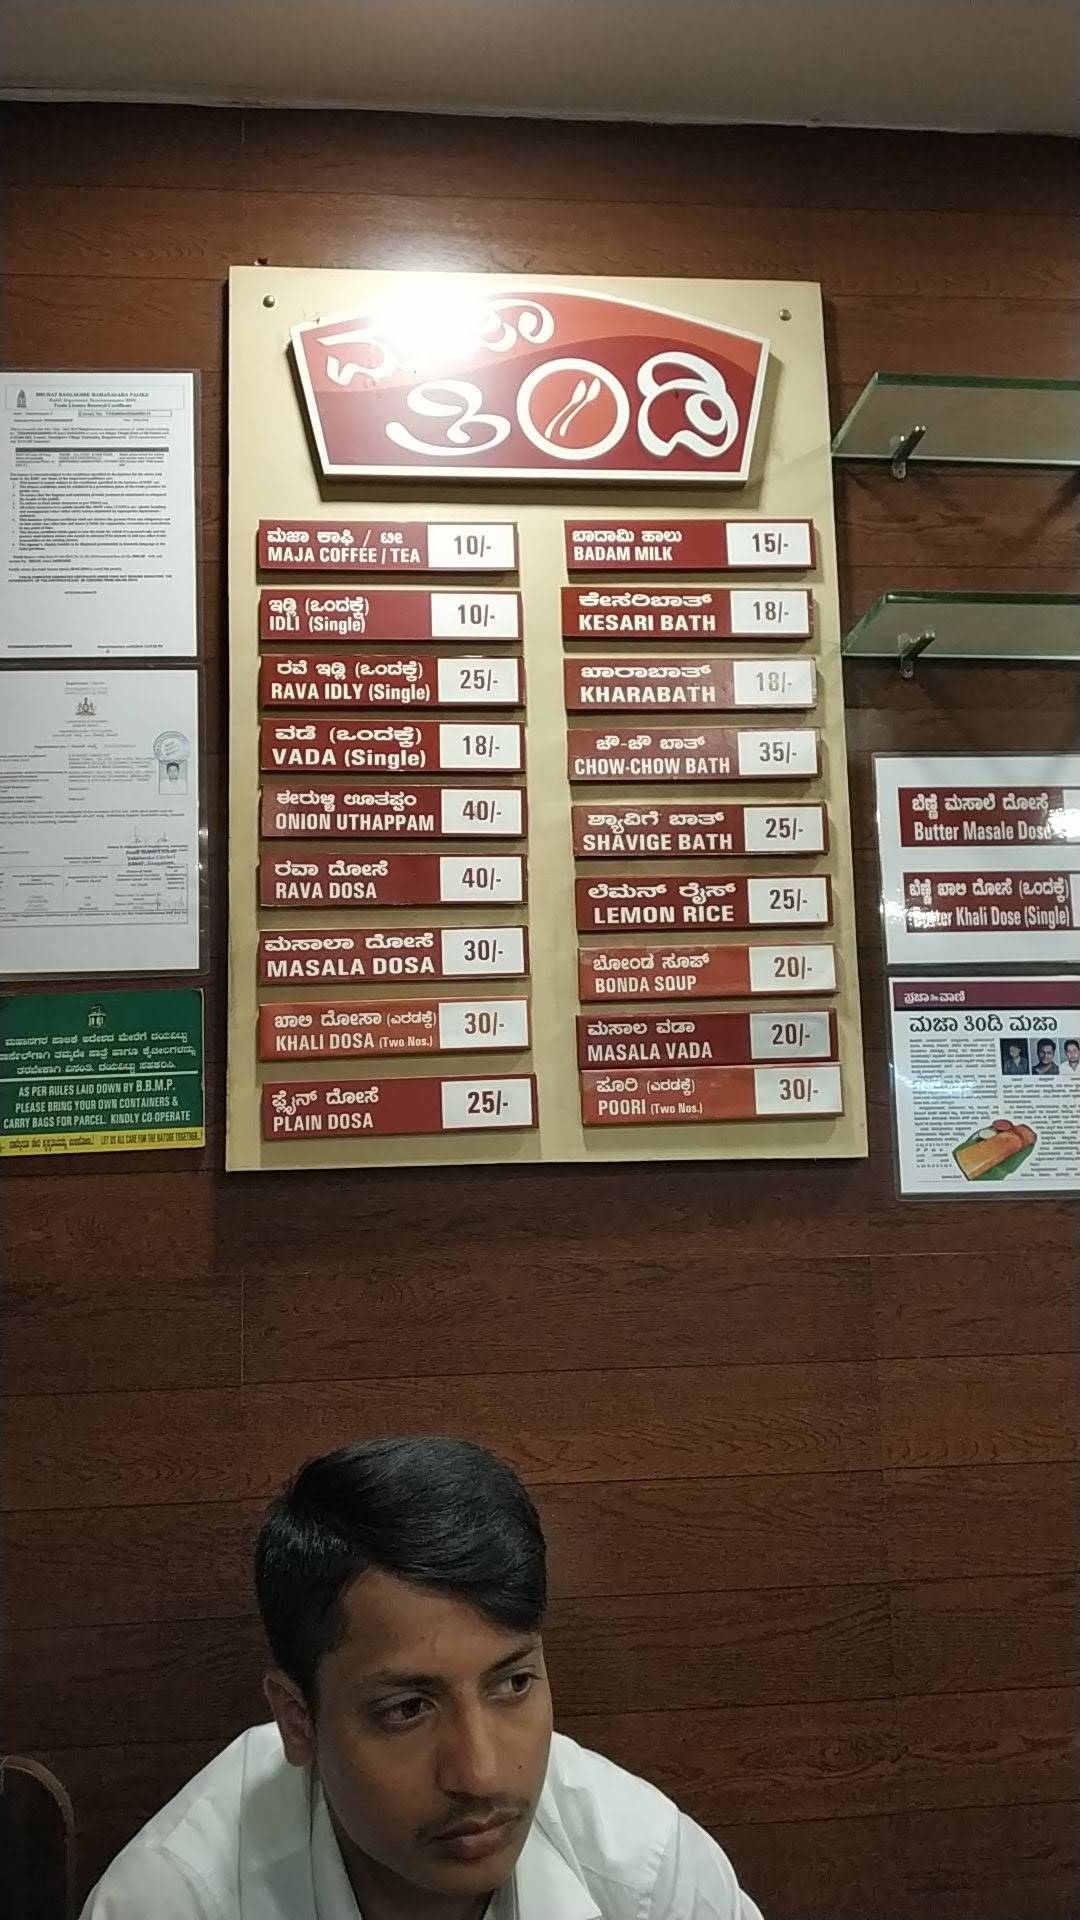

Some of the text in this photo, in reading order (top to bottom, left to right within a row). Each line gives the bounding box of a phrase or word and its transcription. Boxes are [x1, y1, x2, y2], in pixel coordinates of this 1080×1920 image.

[267, 528, 309, 542] ಮಜಾ
[318, 529, 353, 545] ಕಾಫಿ
[363, 530, 371, 546] /
[573, 530, 681, 542] ಬಾದಾಮಿ ಹಾಲು
[752, 532, 788, 554] 15/-
[268, 547, 420, 564] MAJA COFFEE / TEA
[454, 535, 491, 558] 10/-
[574, 547, 673, 561] BADAM MILK
[269, 597, 369, 618] ಇಡ್ಲಿ (ಒಂದಕ್ಕೆ)
[579, 592, 712, 607] ಕೇಸರಿಬಾತ್
[458, 604, 496, 627] 10/-
[753, 601, 789, 623] 18/-
[269, 616, 365, 634] IDLI (Single)
[579, 615, 715, 631] KESARI BATH
[277, 660, 423, 681] ರವೆ ಇಡ್ಲಿ (ಒಂದಕ್ಕೆ)
[581, 664, 711, 678] ಖಾರಾಬಾತ್
[460, 669, 498, 692] 25/-
[756, 672, 792, 693] 18/-
[271, 683, 430, 703] RAVA IDLY (Single)
[580, 686, 715, 703] KHARABATH
[275, 726, 421, 747] ವಡೆ (ಒಂದಕ್ಕೆ)
[660, 736, 705, 749] ಬಾತ್
[463, 735, 500, 758] 18/-
[759, 741, 797, 764] 35/-
[272, 749, 426, 769] VADA (Single)
[575, 757, 730, 775] CHOW-CHOW BATH
[462, 800, 501, 823] 40/-
[945, 793, 995, 811] ಮಸಾಲೆ
[276, 813, 434, 831] ONION UTHAPPAM
[669, 811, 724, 825] ಬಾತ್
[765, 818, 803, 840] 25/-
[914, 821, 959, 841] Butter
[963, 821, 1014, 840] Masale
[583, 833, 732, 851] SHAVIGE BATH
[275, 860, 388, 876] ರವಾ ದೋಸೆ
[462, 868, 501, 890] 40/-
[972, 877, 1012, 896] ದೋಸೆ
[276, 882, 376, 898] RAVA DOSA
[679, 882, 736, 904] ರೈಸ್
[769, 889, 807, 912] 25/-
[594, 905, 734, 924] LEMON RICE
[956, 906, 988, 926] Khali
[991, 906, 1021, 926] Dose
[1024, 905, 1070, 929] (Single)
[264, 933, 433, 952] ಮಸಾಲಾ ದೋಸೆ
[464, 939, 504, 963] 30/-
[268, 957, 435, 978] MASALA DOSA
[662, 952, 709, 969] ಸೂಪ್
[774, 956, 812, 979] 20/-
[596, 975, 697, 993] BONDA SOUP
[274, 1013, 312, 1028] ಖಾಲಿ
[321, 1010, 382, 1027] ದೋಸಾ
[464, 1012, 504, 1035] 30/-
[587, 1019, 695, 1036] ಮಸಾಲ ವಡಾ
[909, 1013, 1058, 1032] ಮಜಾ ತಿಂಡಿ ಮಜಾ
[276, 1033, 433, 1052] KHALI DOSA (Two Nos.)
[772, 1023, 810, 1047] 20/-
[588, 1042, 713, 1062] MASALA VADA
[19, 1079, 175, 1097] AS PER RULES LAID DOWN BY B.B.M.P.
[596, 1076, 638, 1093] ಪೂರಿ
[779, 1078, 818, 1102] 30/-
[16, 1096, 178, 1113] PLEASE BRING YOUR OWN CONTAINERS &
[326, 1086, 379, 1105] ದೋಸೆ
[468, 1091, 508, 1115] 25/-
[598, 1099, 702, 1116] POORI (Two Nos.)
[4, 1118, 30, 1129] CARRY
[32, 1117, 54, 1128] BAGS
[56, 1116, 72, 1126] FOR
[111, 1113, 140, 1124] KINDLY
[274, 1112, 374, 1132] PLAIN DOSA
